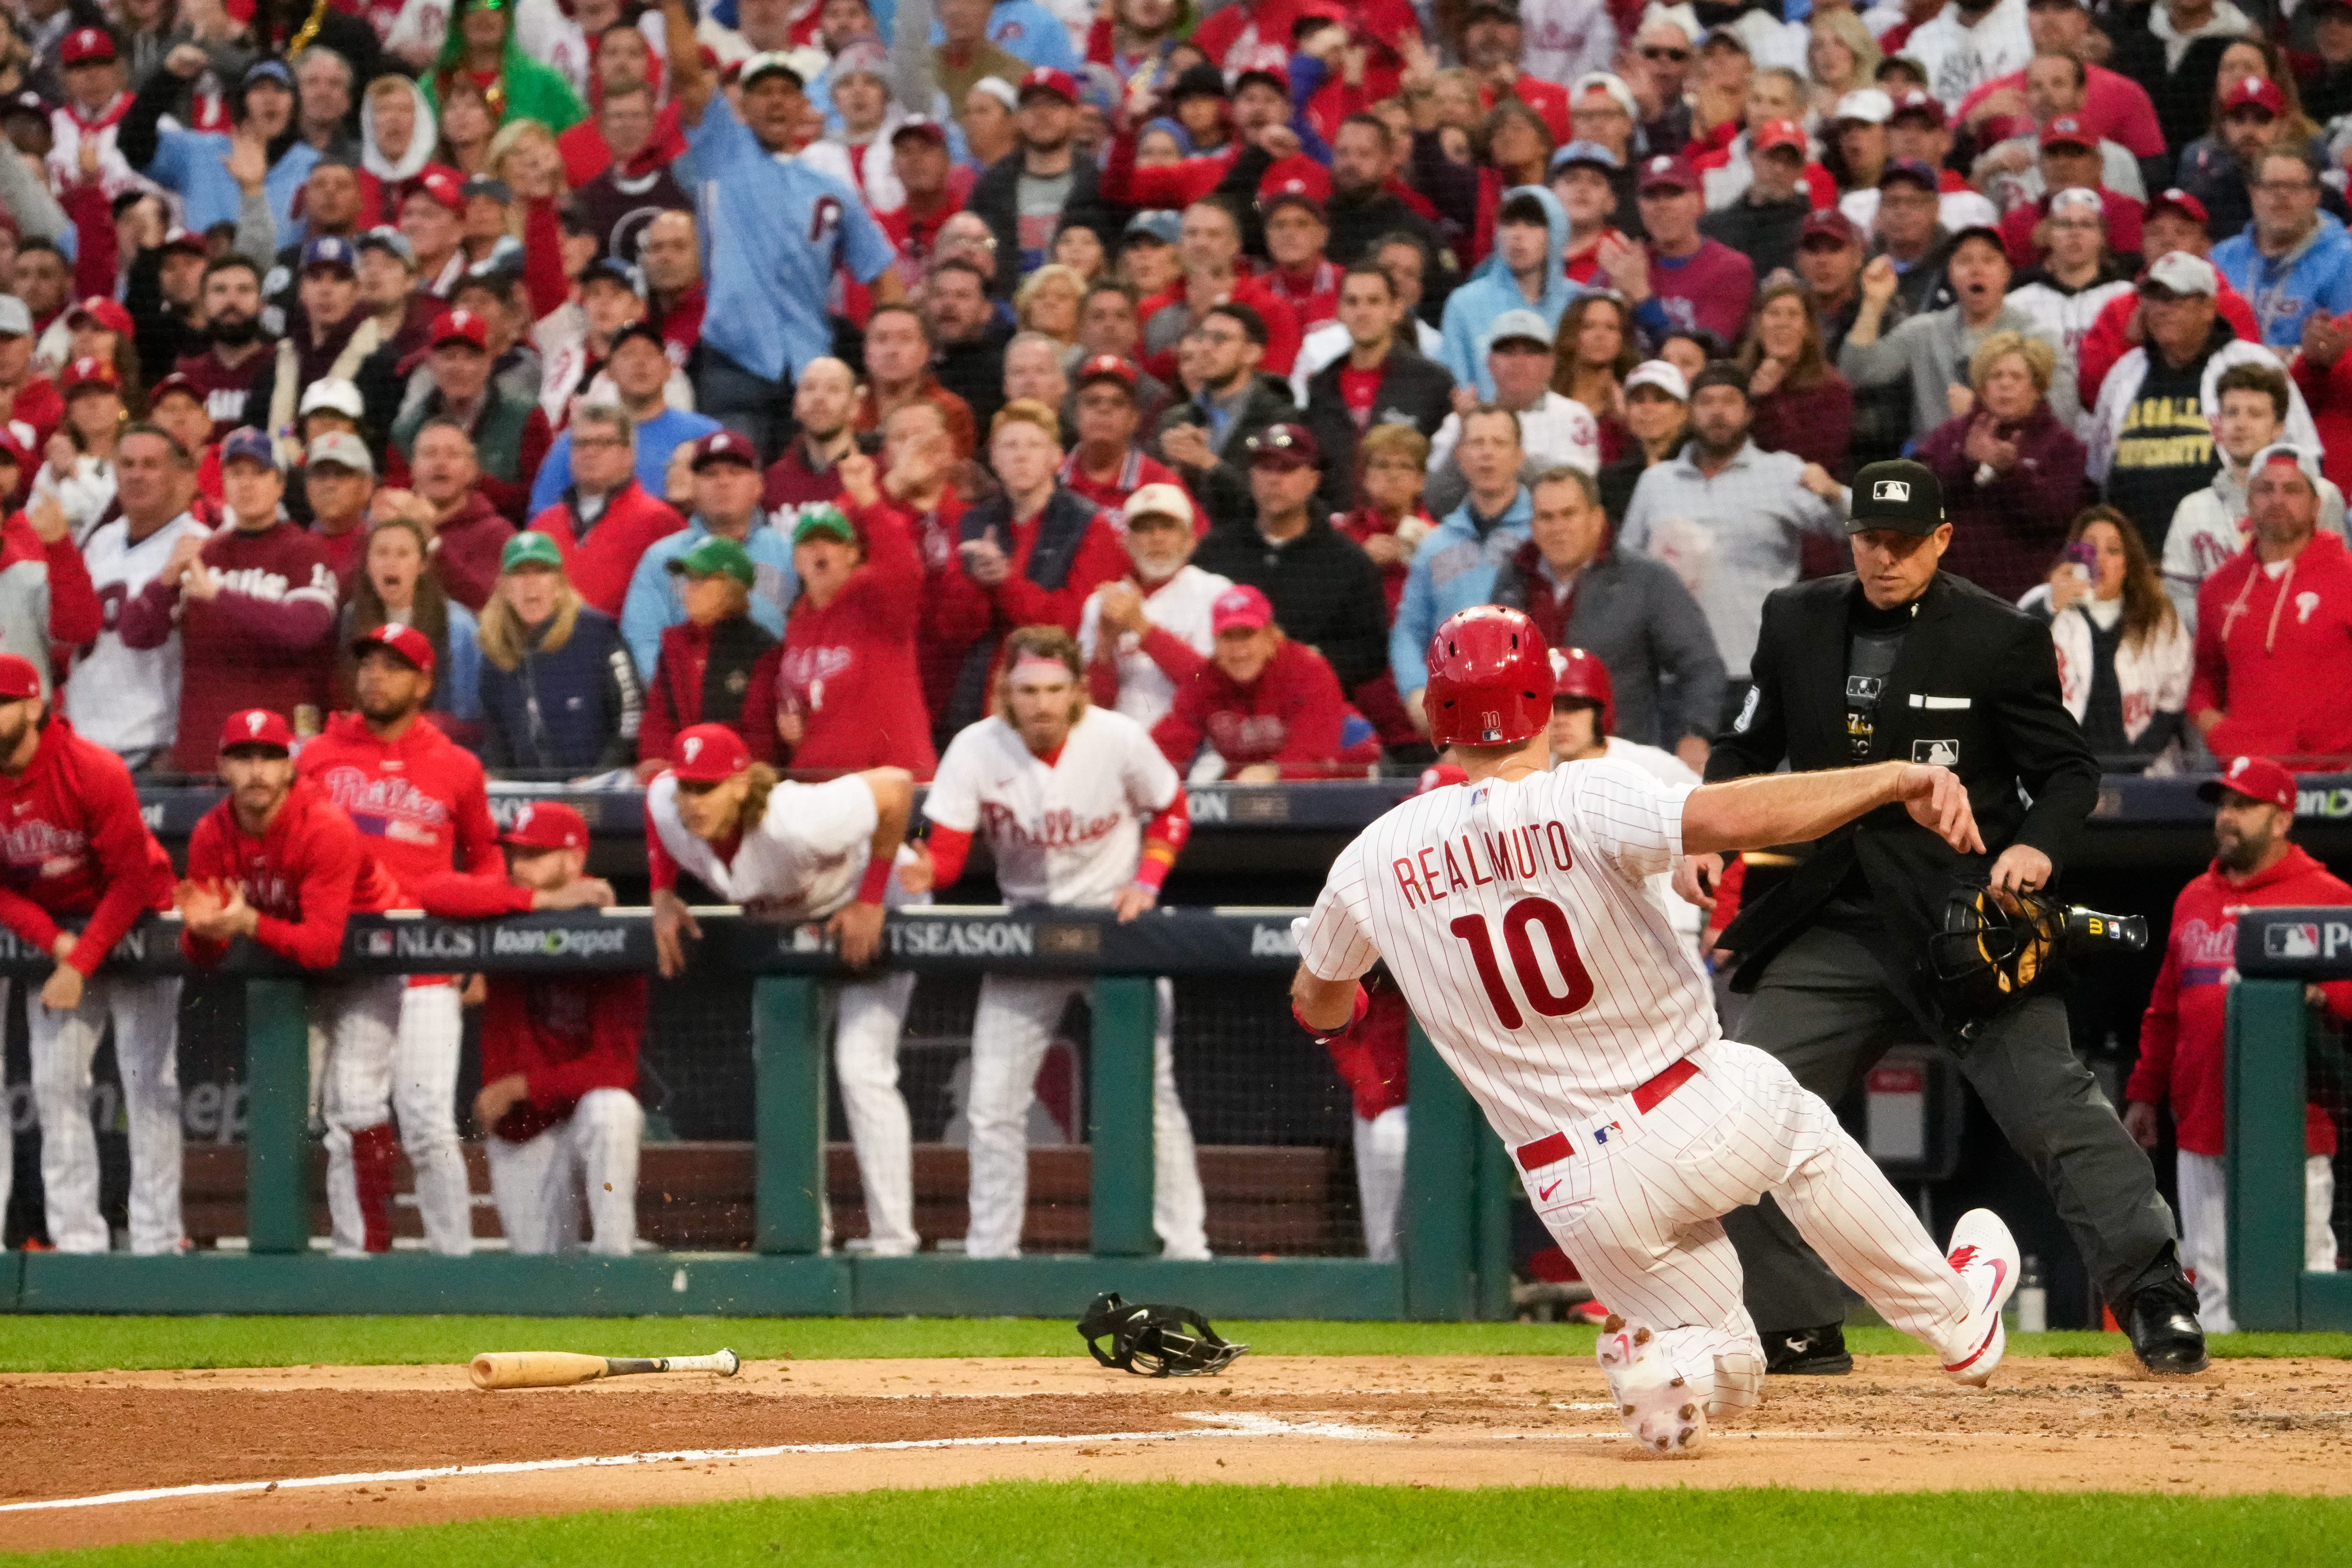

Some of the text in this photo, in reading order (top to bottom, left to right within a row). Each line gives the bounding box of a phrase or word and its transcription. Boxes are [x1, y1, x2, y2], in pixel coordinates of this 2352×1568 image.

[1482, 711, 1500, 729] 10
[979, 798, 1122, 851] Phillies
[1392, 820, 1573, 910] REALMUTO
[397, 926, 475, 959] NLCS
[887, 921, 1035, 956] TSEASON
[1450, 897, 1594, 1030] 10
